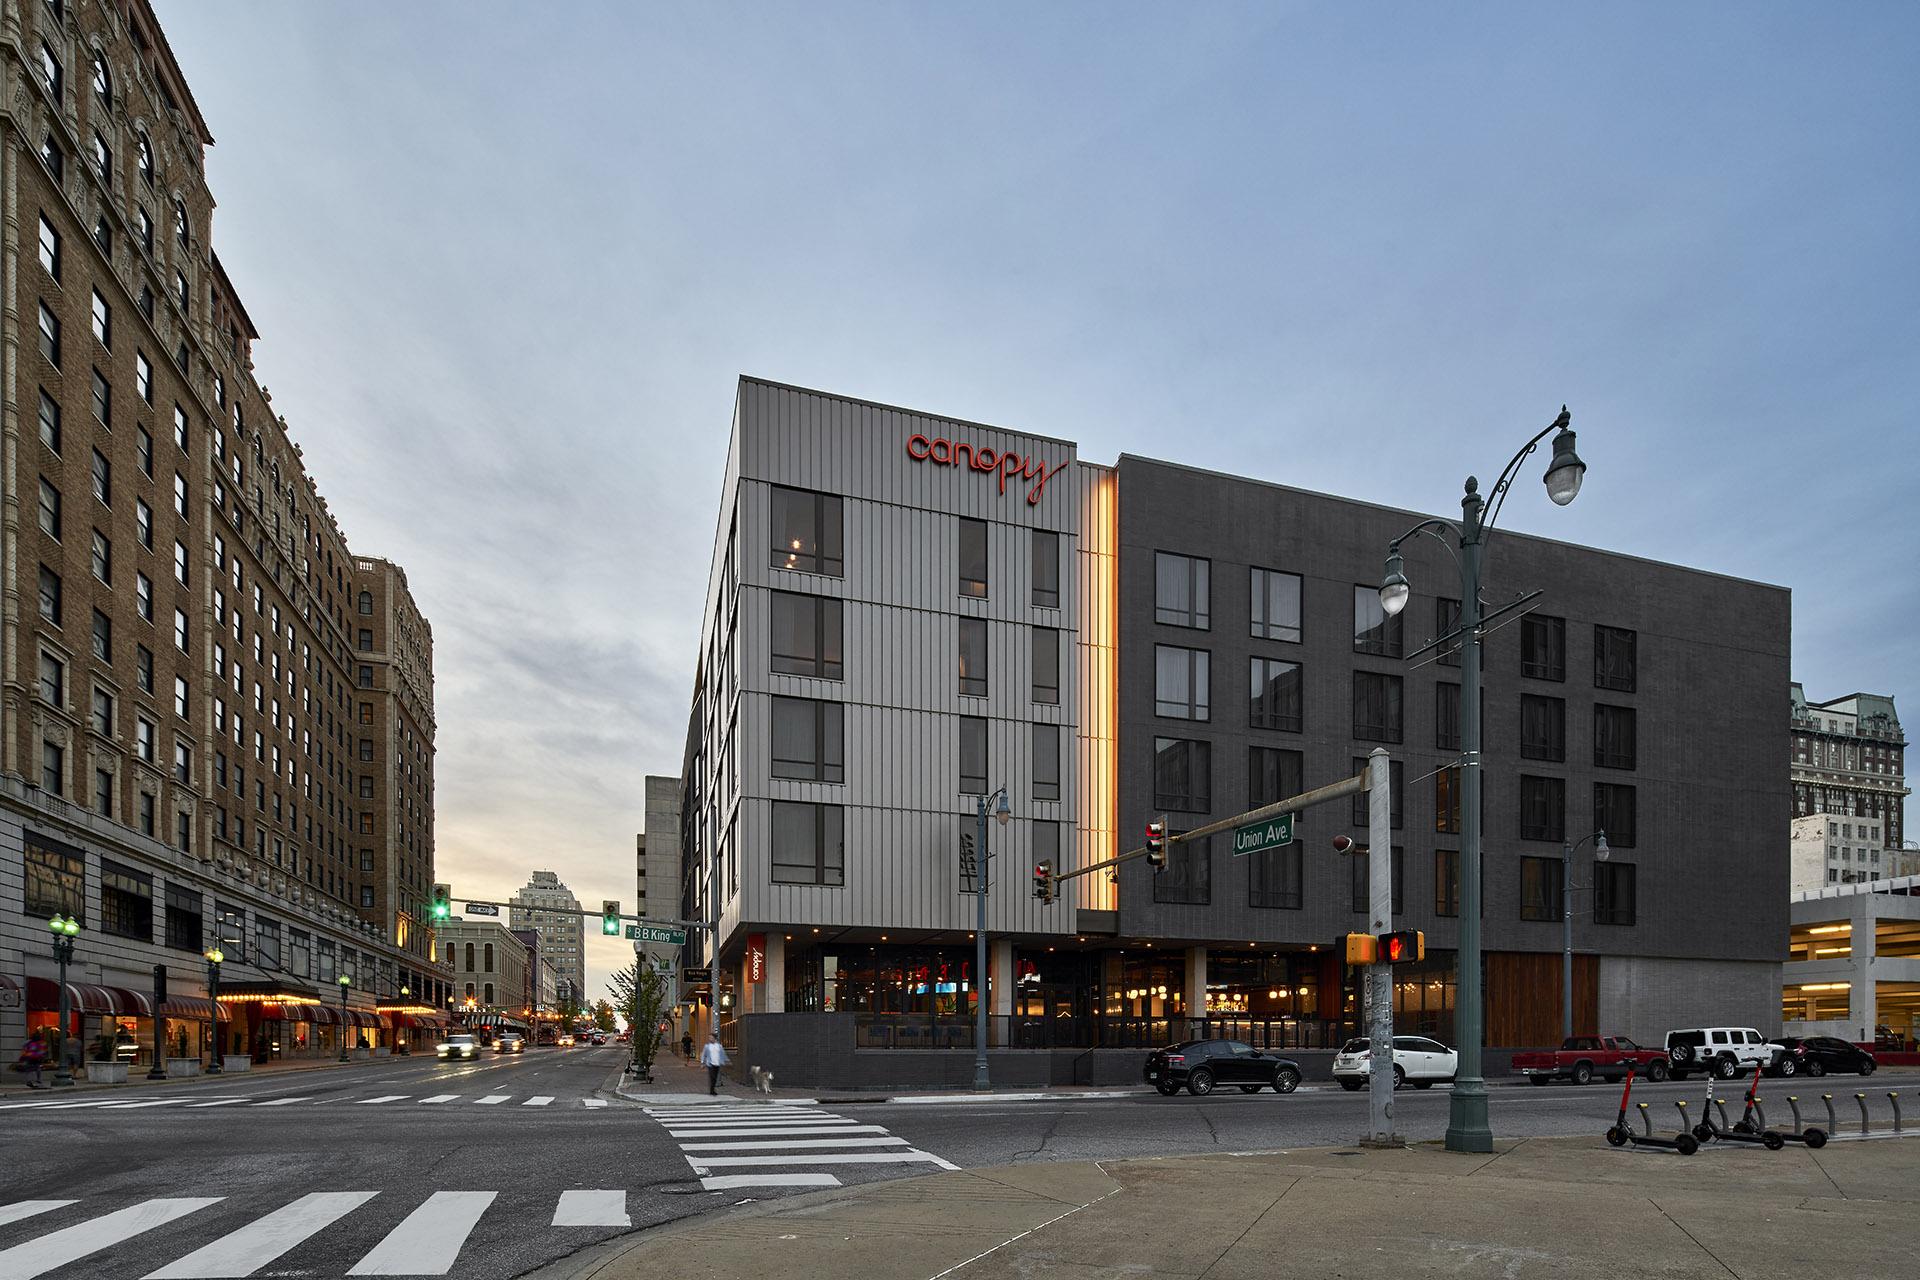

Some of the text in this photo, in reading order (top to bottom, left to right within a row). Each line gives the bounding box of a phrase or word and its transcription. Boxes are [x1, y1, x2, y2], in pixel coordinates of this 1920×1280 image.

[907, 433, 1070, 506] canopy
[1237, 824, 1288, 850] Union Ave.
[650, 929, 671, 943] King
[752, 946, 764, 981] canopy
